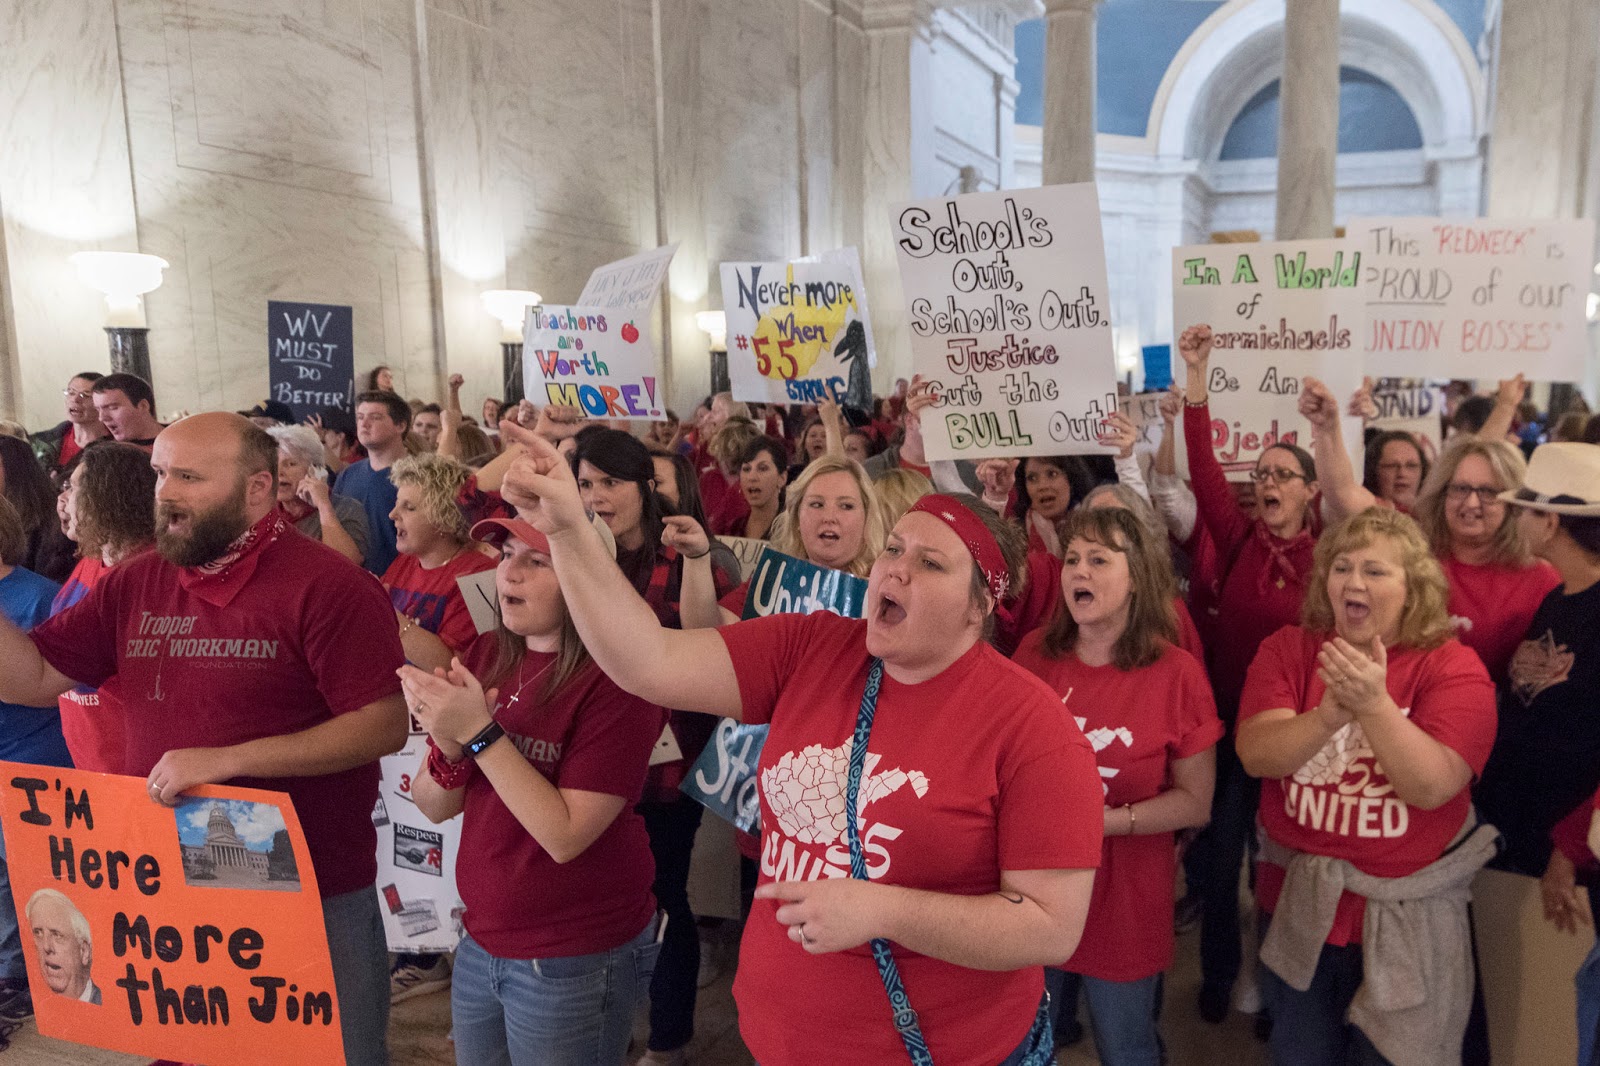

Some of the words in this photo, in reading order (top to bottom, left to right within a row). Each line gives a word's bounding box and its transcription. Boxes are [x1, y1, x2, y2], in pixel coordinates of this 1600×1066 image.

[900, 198, 1053, 258] School's
[1369, 227, 1421, 257] This
[1545, 242, 1566, 260] is
[952, 251, 1024, 293] Out,
[1183, 257, 1222, 286] In
[1231, 253, 1260, 284] A
[1274, 251, 1362, 289] World
[1471, 266, 1503, 306] of
[1517, 281, 1577, 308] our
[283, 309, 333, 338] WV
[532, 305, 608, 333] Teachers
[911, 294, 1032, 337] School's
[1039, 286, 1109, 331] Out.
[1236, 292, 1263, 320] of
[557, 335, 584, 351] are
[772, 311, 830, 344] When
[1212, 314, 1352, 351] armichaels
[275, 337, 339, 362] MUST
[535, 349, 610, 380] Worth
[946, 334, 1060, 375] Justice
[293, 365, 322, 381] DO
[925, 374, 983, 409] Cut
[1000, 371, 1060, 405] the
[1208, 366, 1241, 393] Be
[1258, 366, 1299, 395] An
[545, 376, 661, 418] MORE!
[945, 409, 1033, 451] BULL
[138, 611, 198, 640] Trooper
[125, 639, 162, 659] ERIC
[169, 637, 280, 660] WORKMAN
[189, 661, 268, 670] FOUNDATION
[10, 776, 94, 831] I'M
[1281, 777, 1409, 839] UNITED
[396, 822, 441, 844] Respect
[49, 834, 161, 896] Here
[112, 911, 264, 970] More
[115, 962, 229, 1026] than
[248, 975, 333, 1026] Jim
